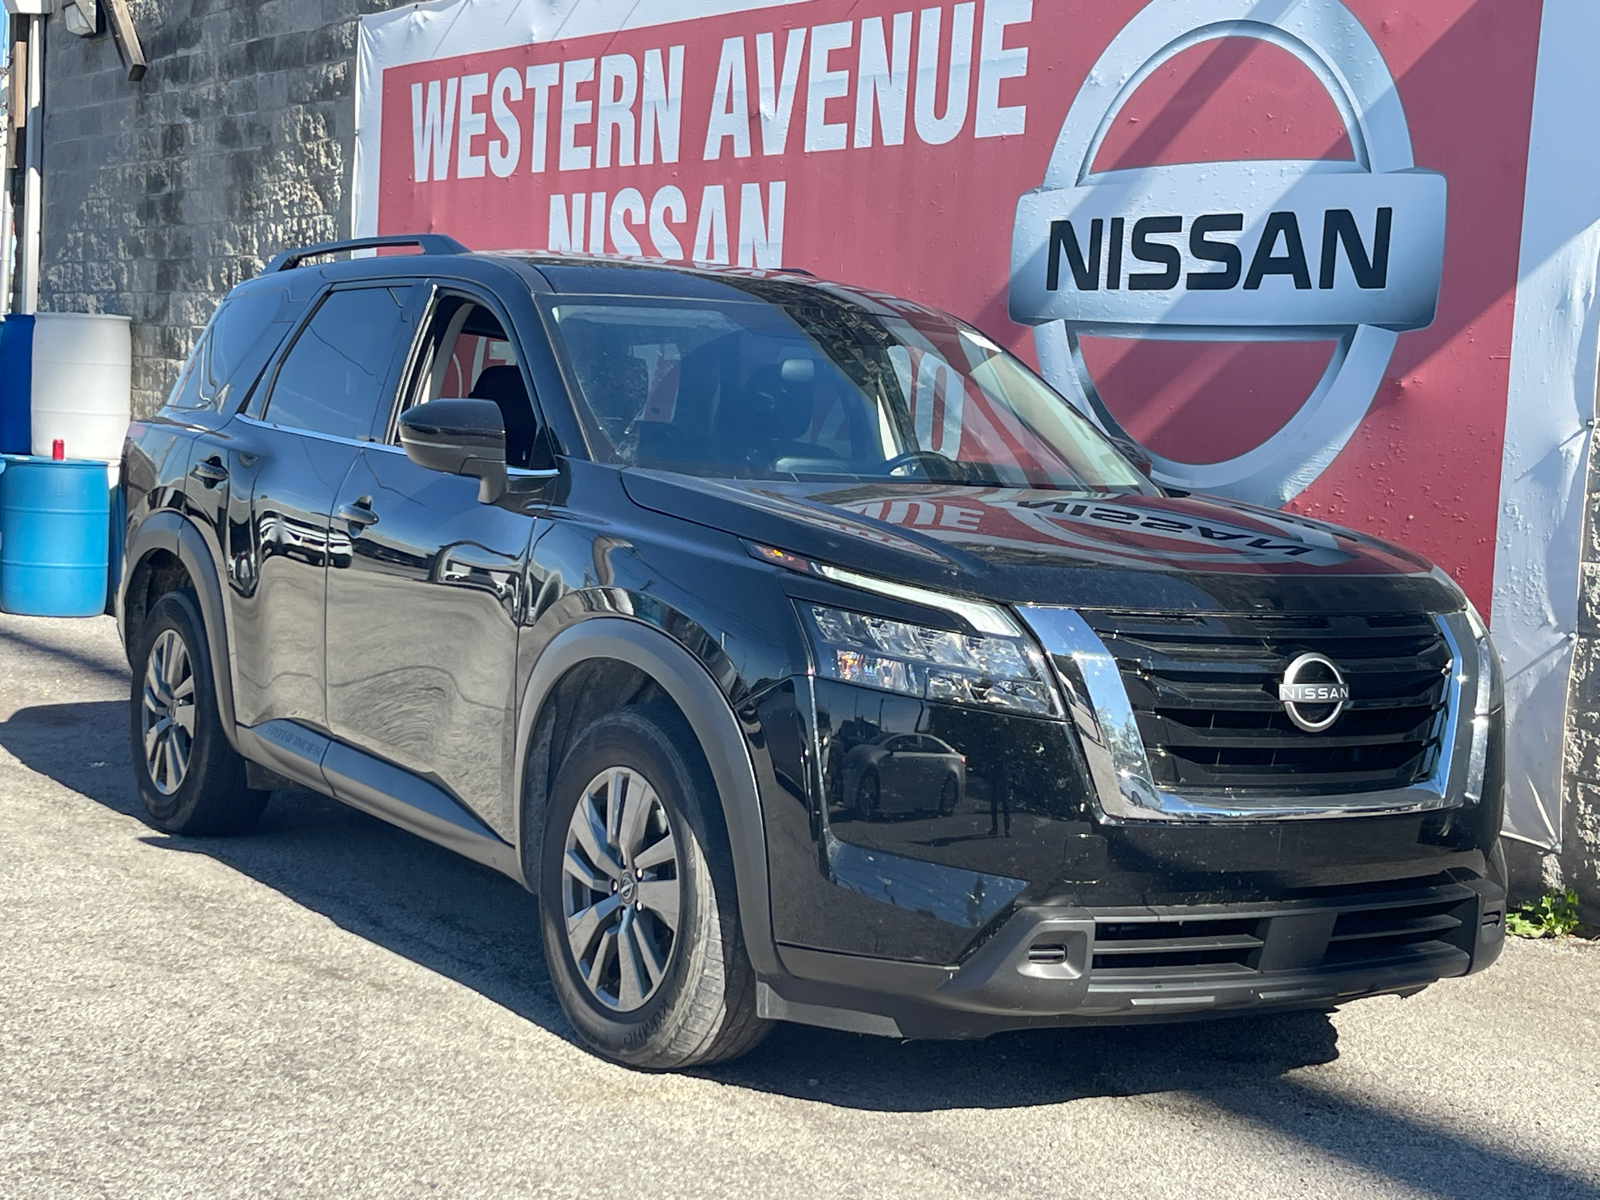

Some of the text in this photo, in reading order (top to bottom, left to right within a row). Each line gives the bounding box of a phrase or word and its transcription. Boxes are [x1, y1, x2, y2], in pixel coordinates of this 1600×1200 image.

[411, 0, 1034, 183] WESTERN AVENUE
[548, 181, 787, 270] NISSAN
[1046, 206, 1393, 291] NISSAN
[1281, 687, 1349, 700] NISSAN
[266, 724, 324, 757] PATHFINDER
